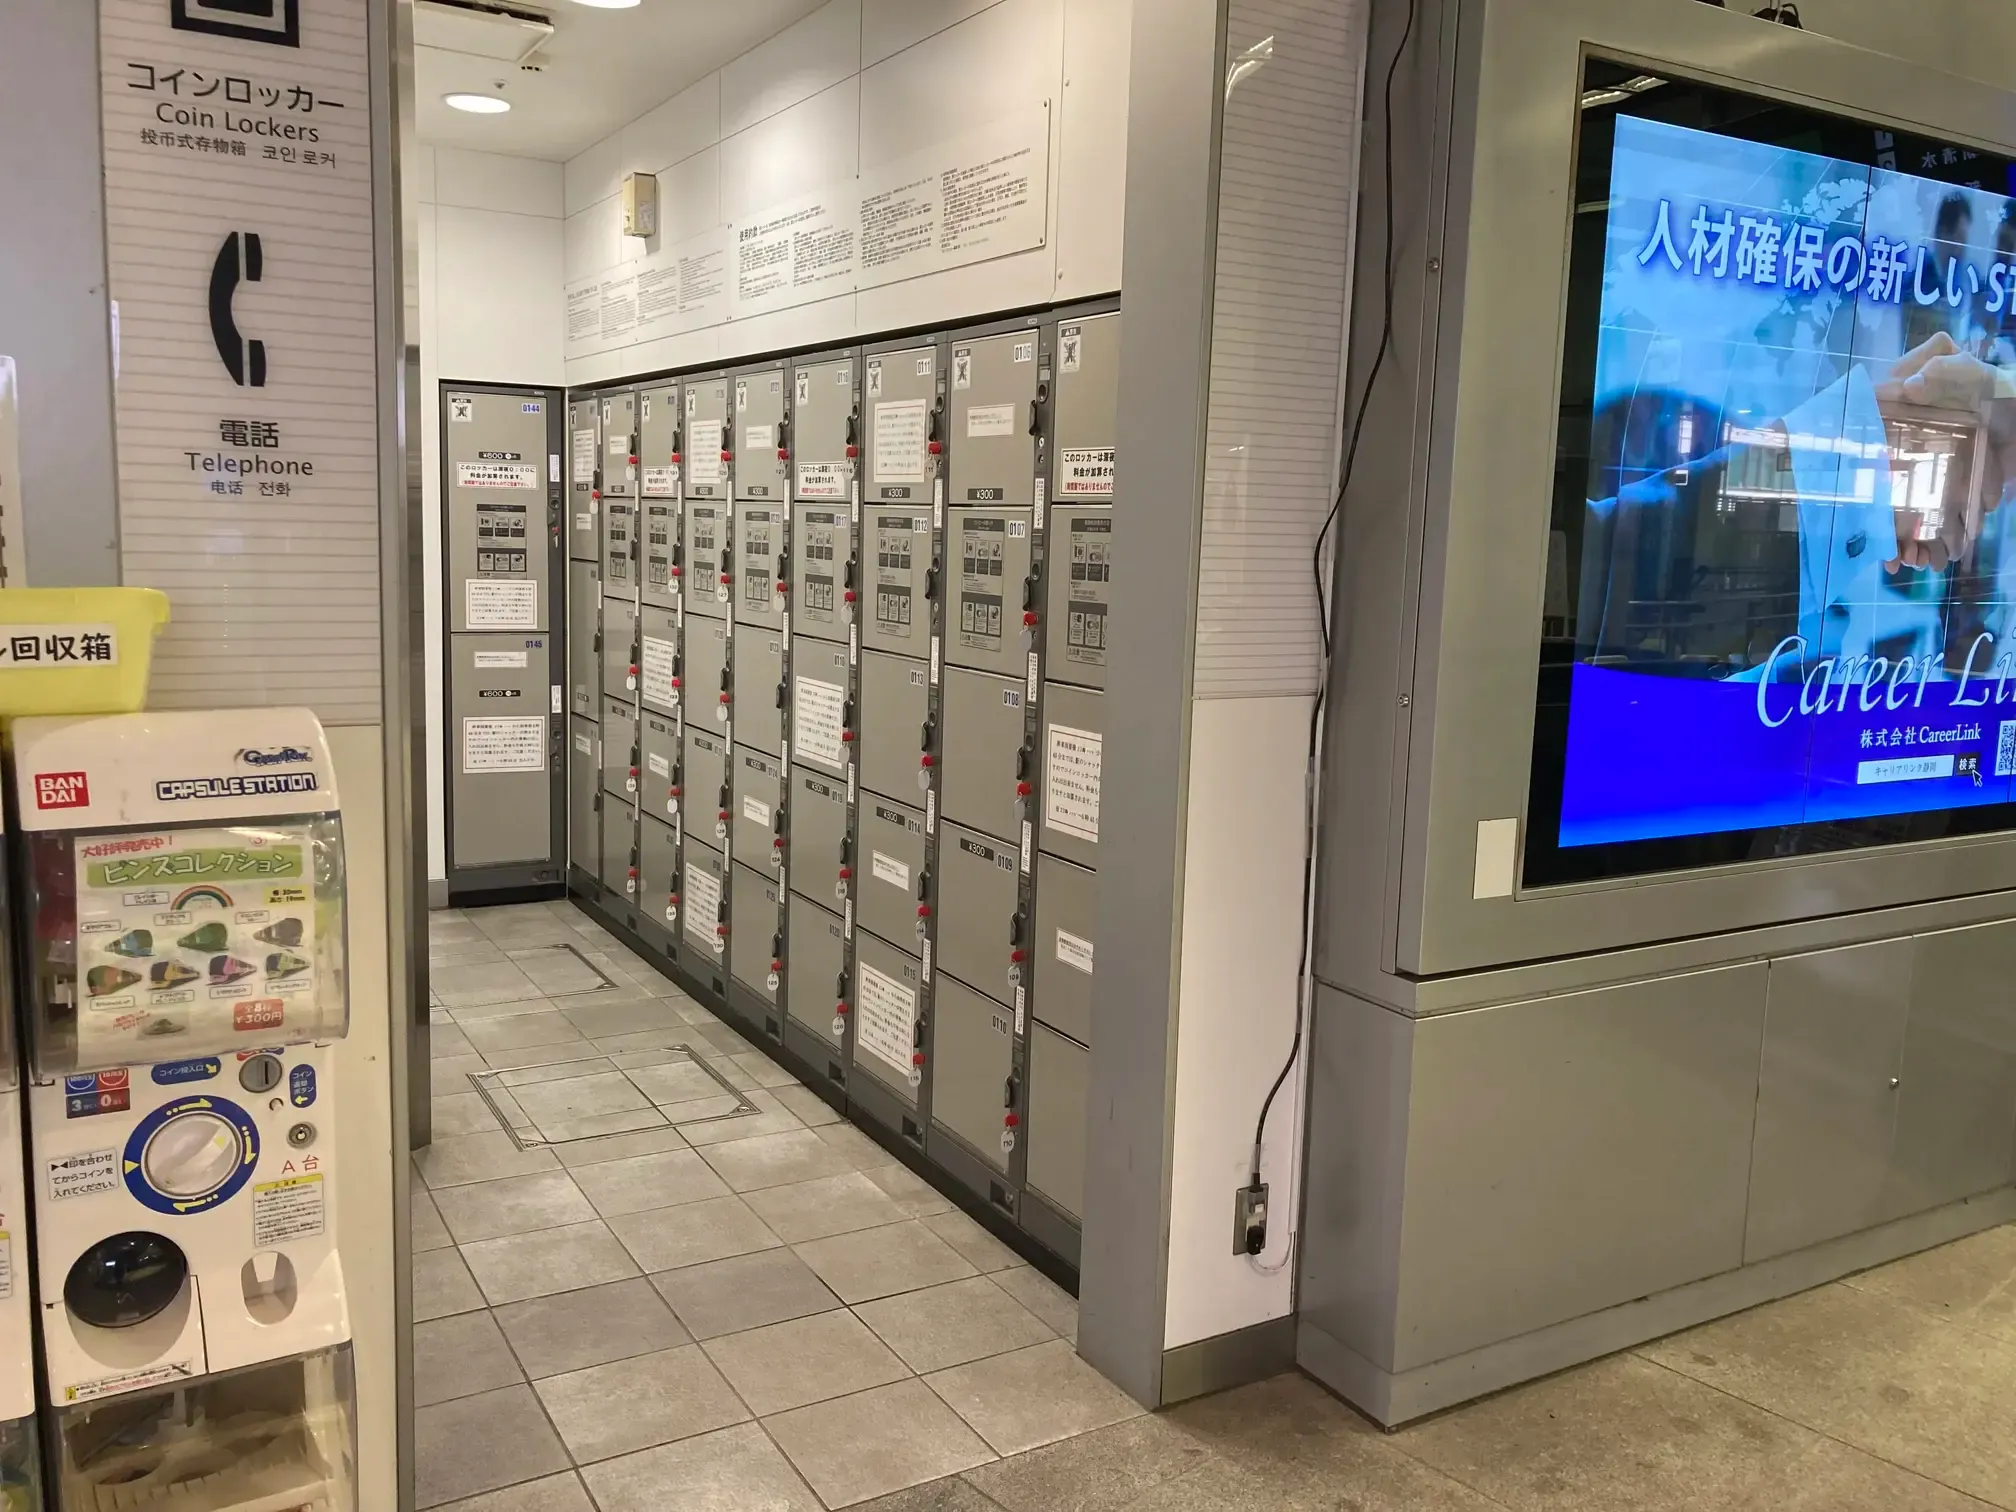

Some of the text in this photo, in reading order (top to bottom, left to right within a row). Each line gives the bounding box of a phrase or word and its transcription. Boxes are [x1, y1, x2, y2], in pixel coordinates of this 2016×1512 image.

[127, 62, 345, 113] コインロッカー
[156, 102, 319, 143] Coin Lockers
[140, 127, 247, 157] 投币式存物箱
[262, 145, 336, 168] 코인 로커
[1638, 199, 2016, 314] 人材確保の新しいS
[522, 404, 540, 413] 0144
[219, 419, 280, 449] 電話
[184, 452, 314, 479] Telephone
[211, 480, 244, 497] 电话
[258, 481, 291, 498] 전화
[976, 489, 994, 500] ¥300
[1009, 522, 1025, 536] 0107
[0, 633, 111, 661] 回収箱
[525, 640, 542, 649] 0145
[1757, 627, 2016, 728] Career Li
[1860, 723, 1981, 749] 株式会社 CareerLink
[39, 776, 83, 791] BAN
[42, 790, 77, 804] DAI
[997, 855, 1013, 871] 0109
[992, 1014, 1007, 1034] 0110
[292, 1070, 312, 1079] コイン
[72, 1099, 82, 1112] 3
[52, 1167, 113, 1185] てからコインを
